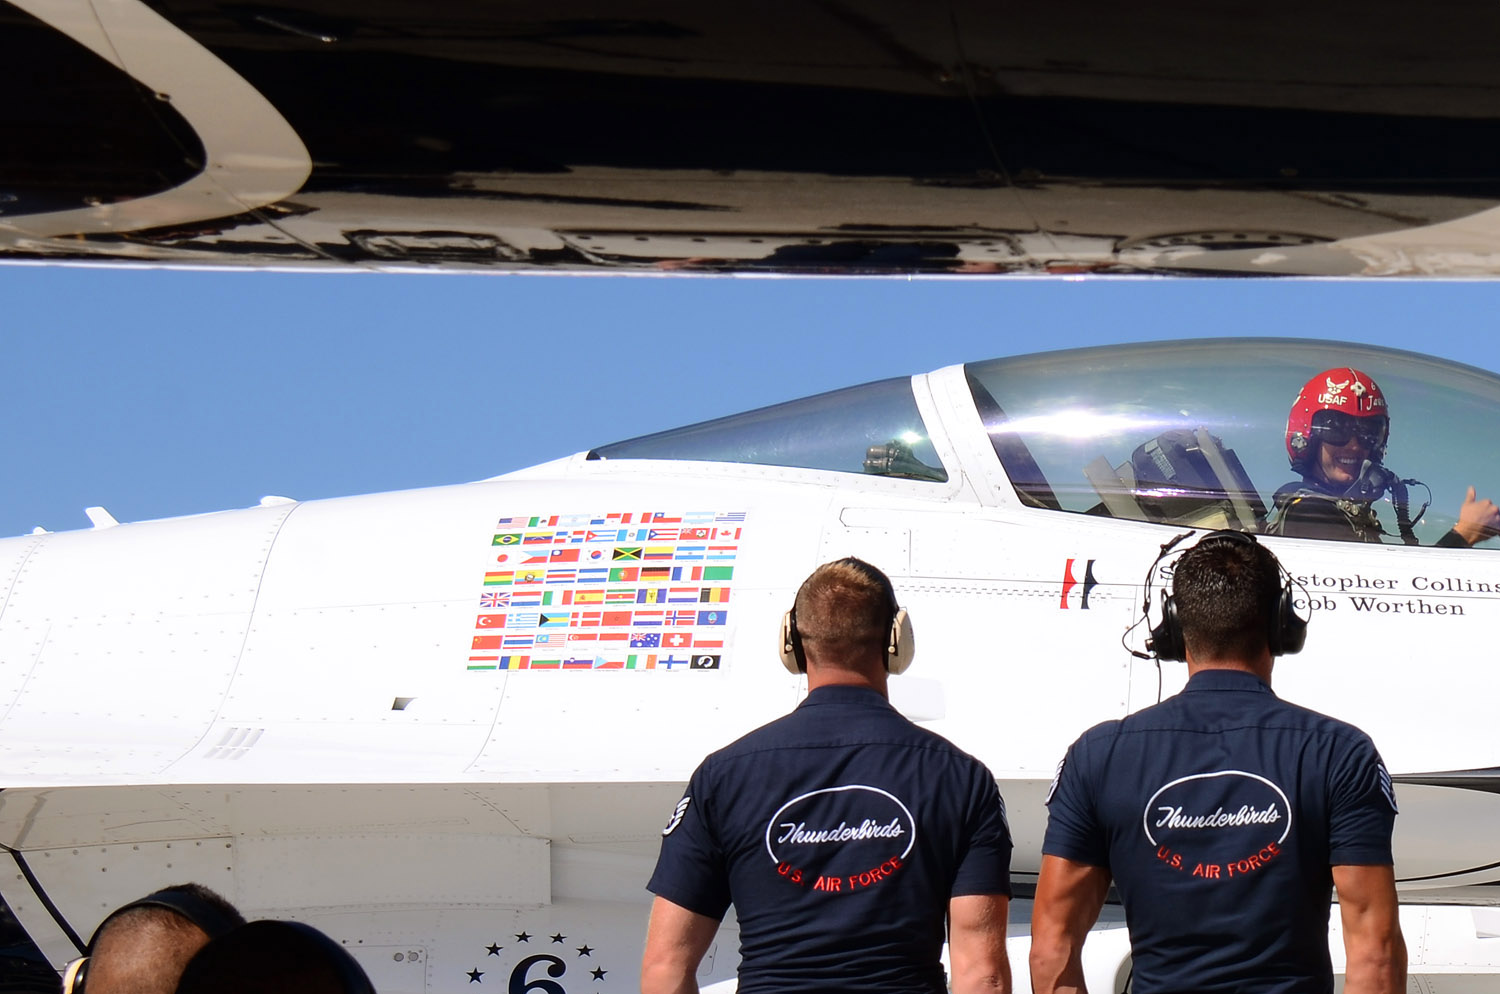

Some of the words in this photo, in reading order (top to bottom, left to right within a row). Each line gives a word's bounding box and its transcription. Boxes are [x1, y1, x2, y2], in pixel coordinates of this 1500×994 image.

[1318, 393, 1347, 406] USAF
[1289, 572, 1398, 592] stopher
[1294, 595, 1337, 612] cob
[1348, 596, 1466, 616] Worthen
[1156, 803, 1281, 829] Thunderbirds
[778, 818, 905, 844] Thunderbirds
[778, 861, 805, 885] U.S.
[813, 876, 841, 892] AIR
[849, 855, 903, 889] FORCE
[1157, 846, 1184, 871] U.S.
[1192, 863, 1220, 879] AIR
[1228, 842, 1281, 878] FORCE
